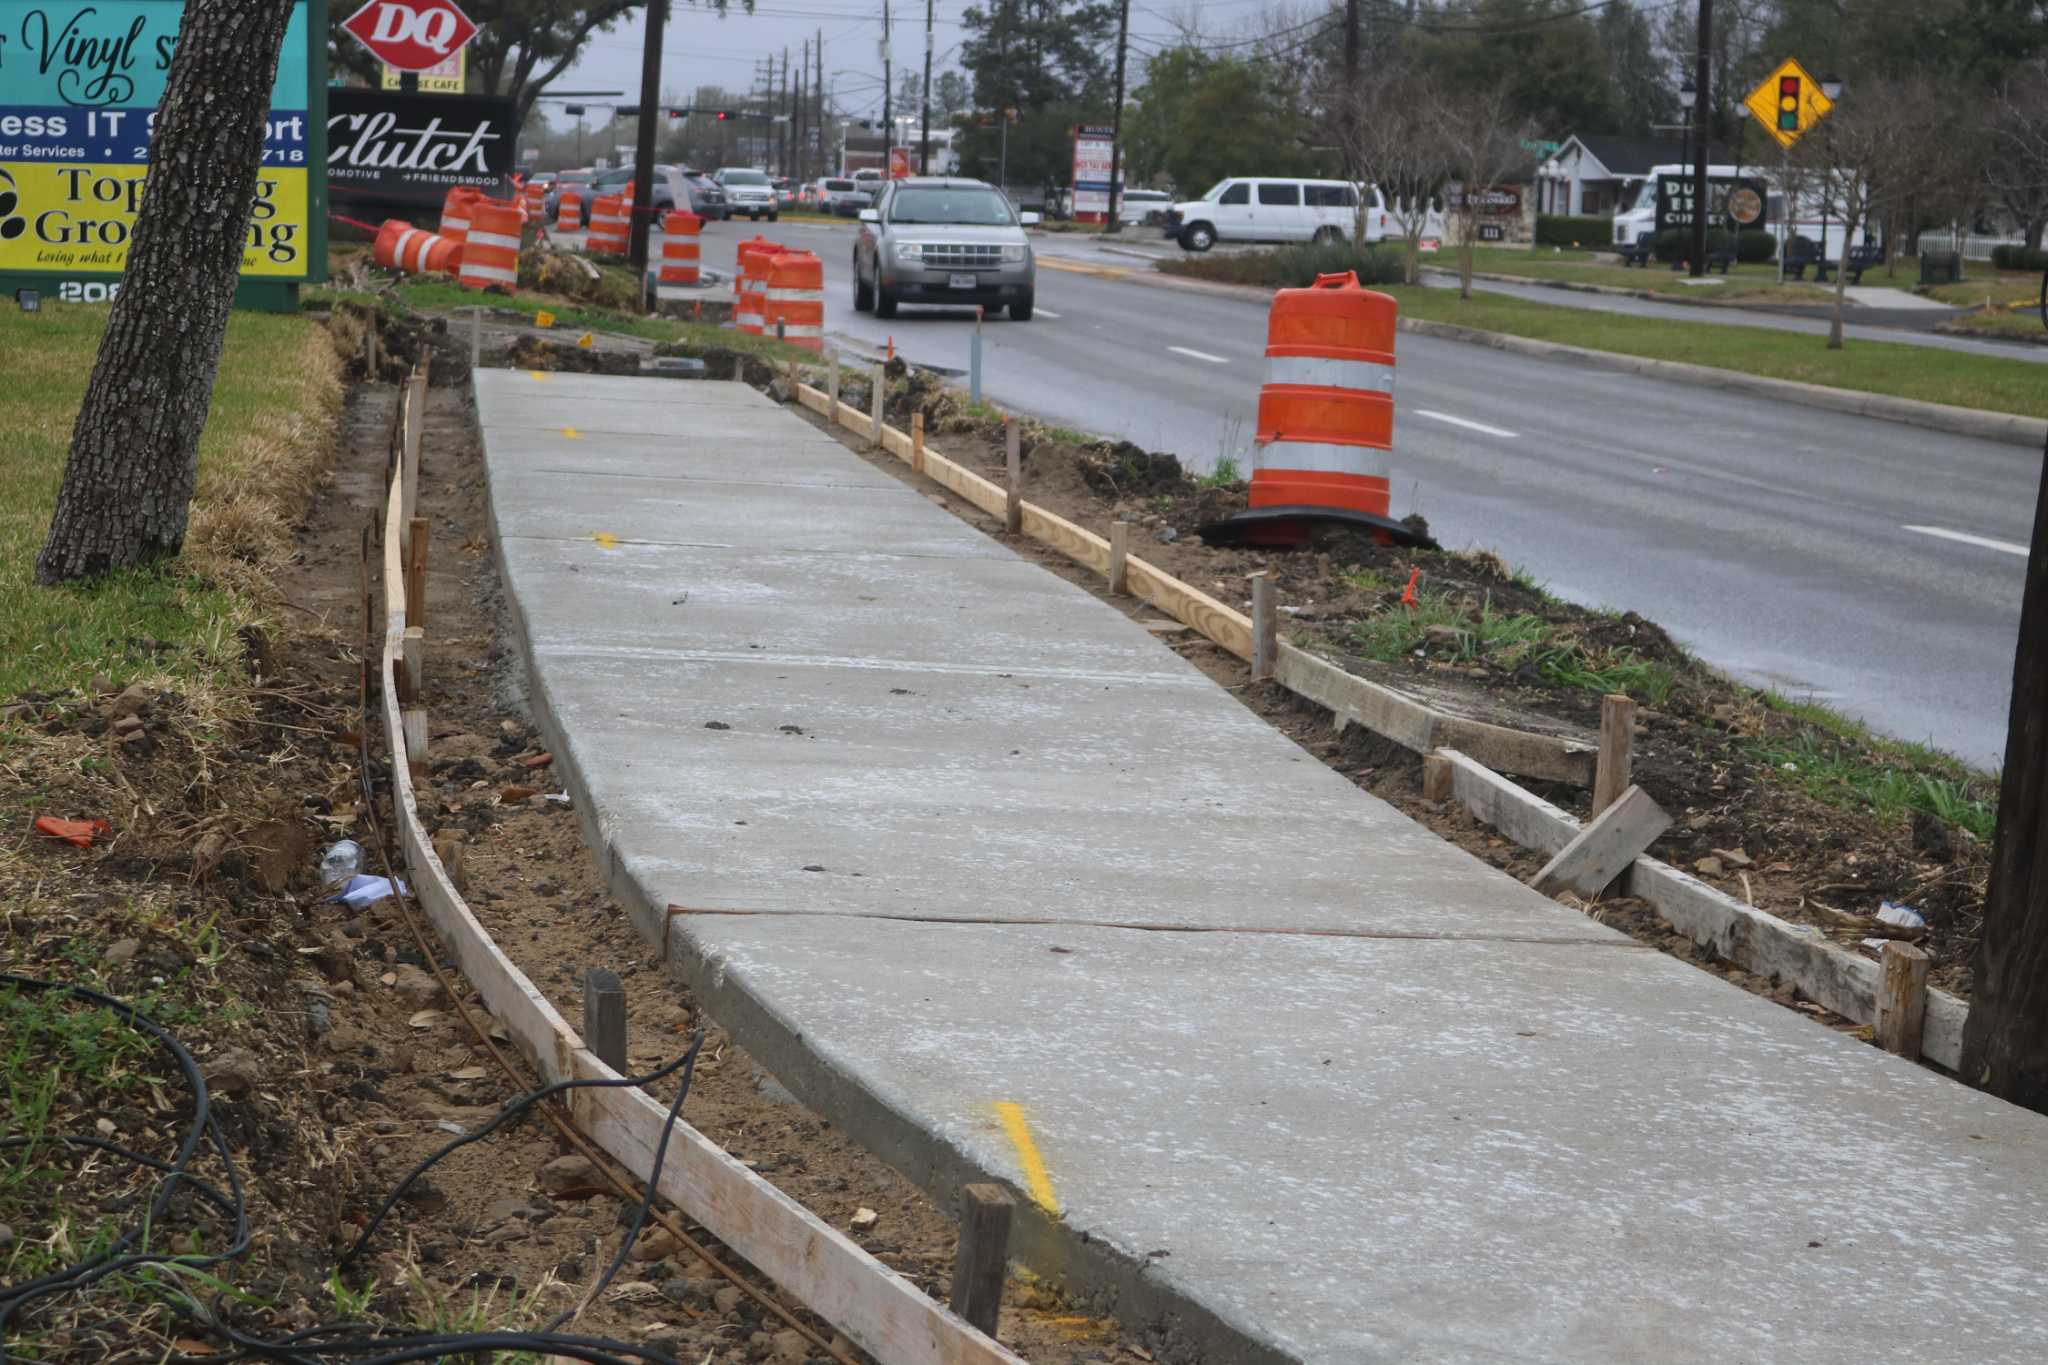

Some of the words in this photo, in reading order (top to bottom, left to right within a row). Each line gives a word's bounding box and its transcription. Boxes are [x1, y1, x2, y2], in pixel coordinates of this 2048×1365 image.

[370, 2, 458, 54] DQ
[21, 7, 147, 107] Vinyl
[88, 111, 127, 138] IT
[22, 144, 86, 158] Services
[328, 112, 500, 173] Clutch
[328, 168, 381, 180] OMOTIVE
[413, 173, 500, 186] FRIENDSWOOD
[79, 251, 112, 264] what
